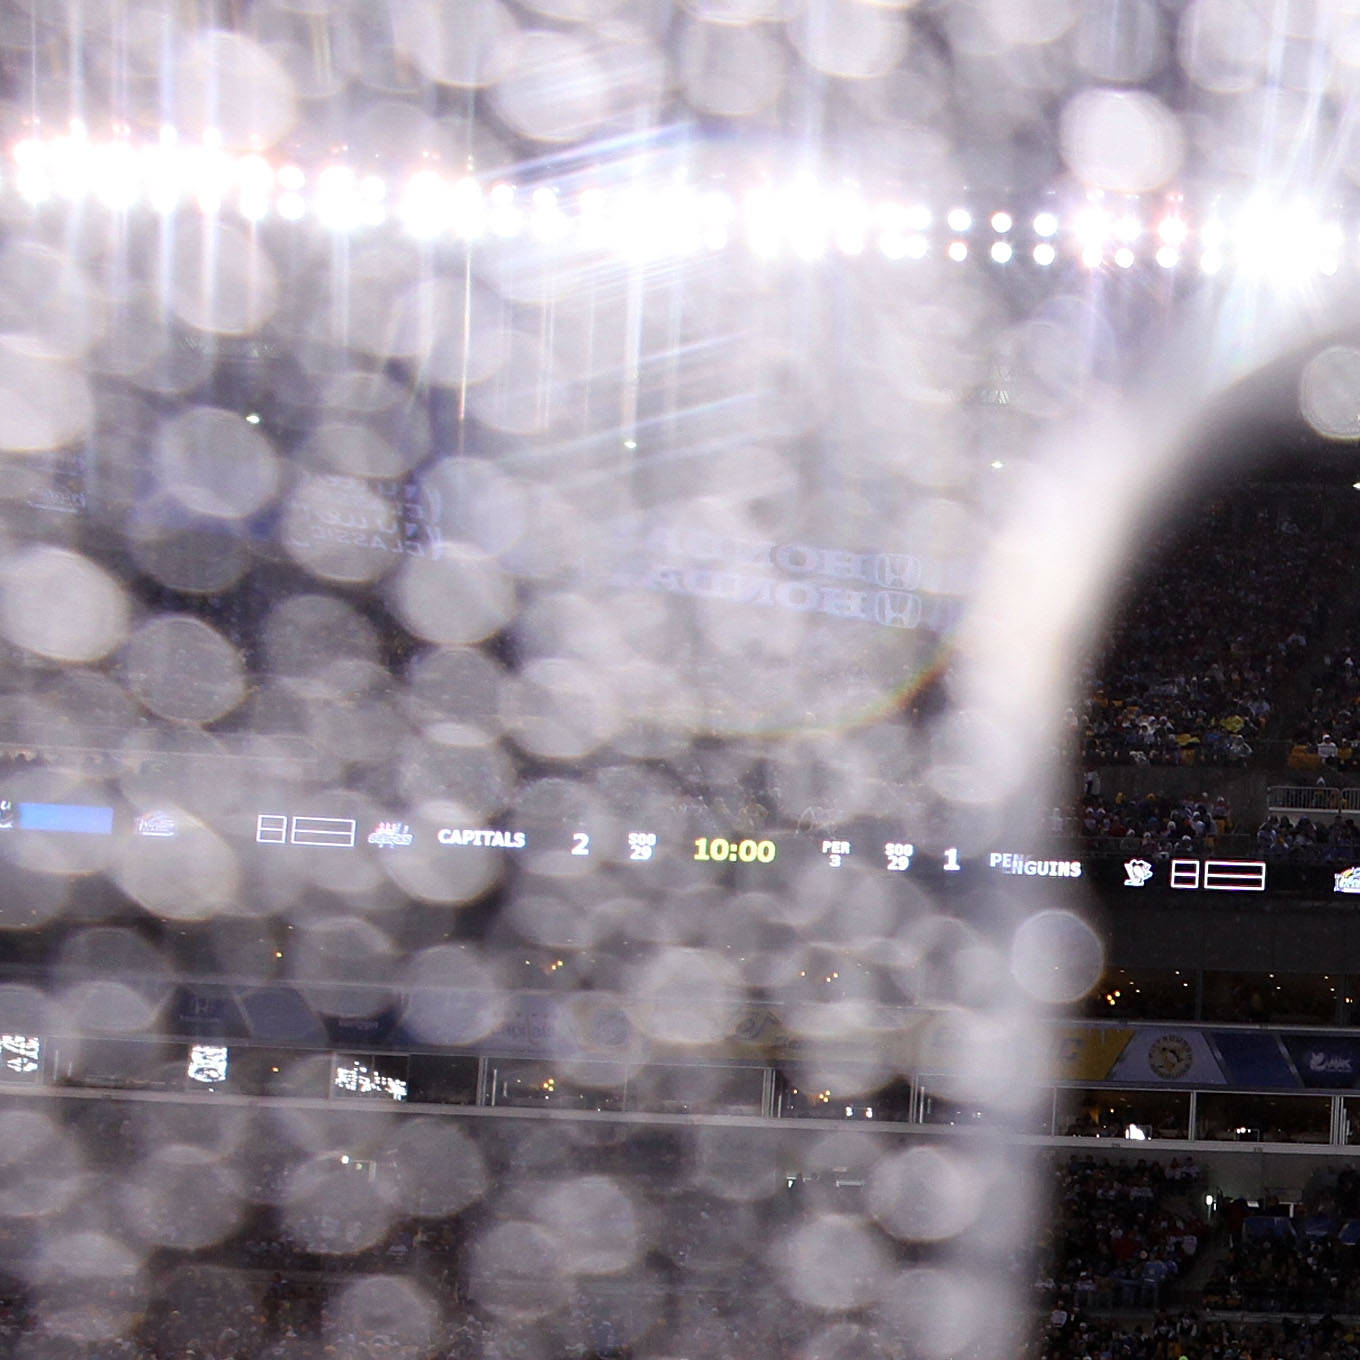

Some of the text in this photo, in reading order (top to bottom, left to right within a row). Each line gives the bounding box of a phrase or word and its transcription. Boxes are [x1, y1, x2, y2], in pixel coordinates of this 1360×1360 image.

[437, 829, 526, 848] CAPITALS
[571, 833, 589, 855] 2
[630, 846, 652, 861] 29
[693, 838, 776, 863] 10:00
[822, 841, 850, 854] PER
[829, 855, 841, 867] 3
[887, 856, 909, 871] 29
[943, 848, 960, 871] 1
